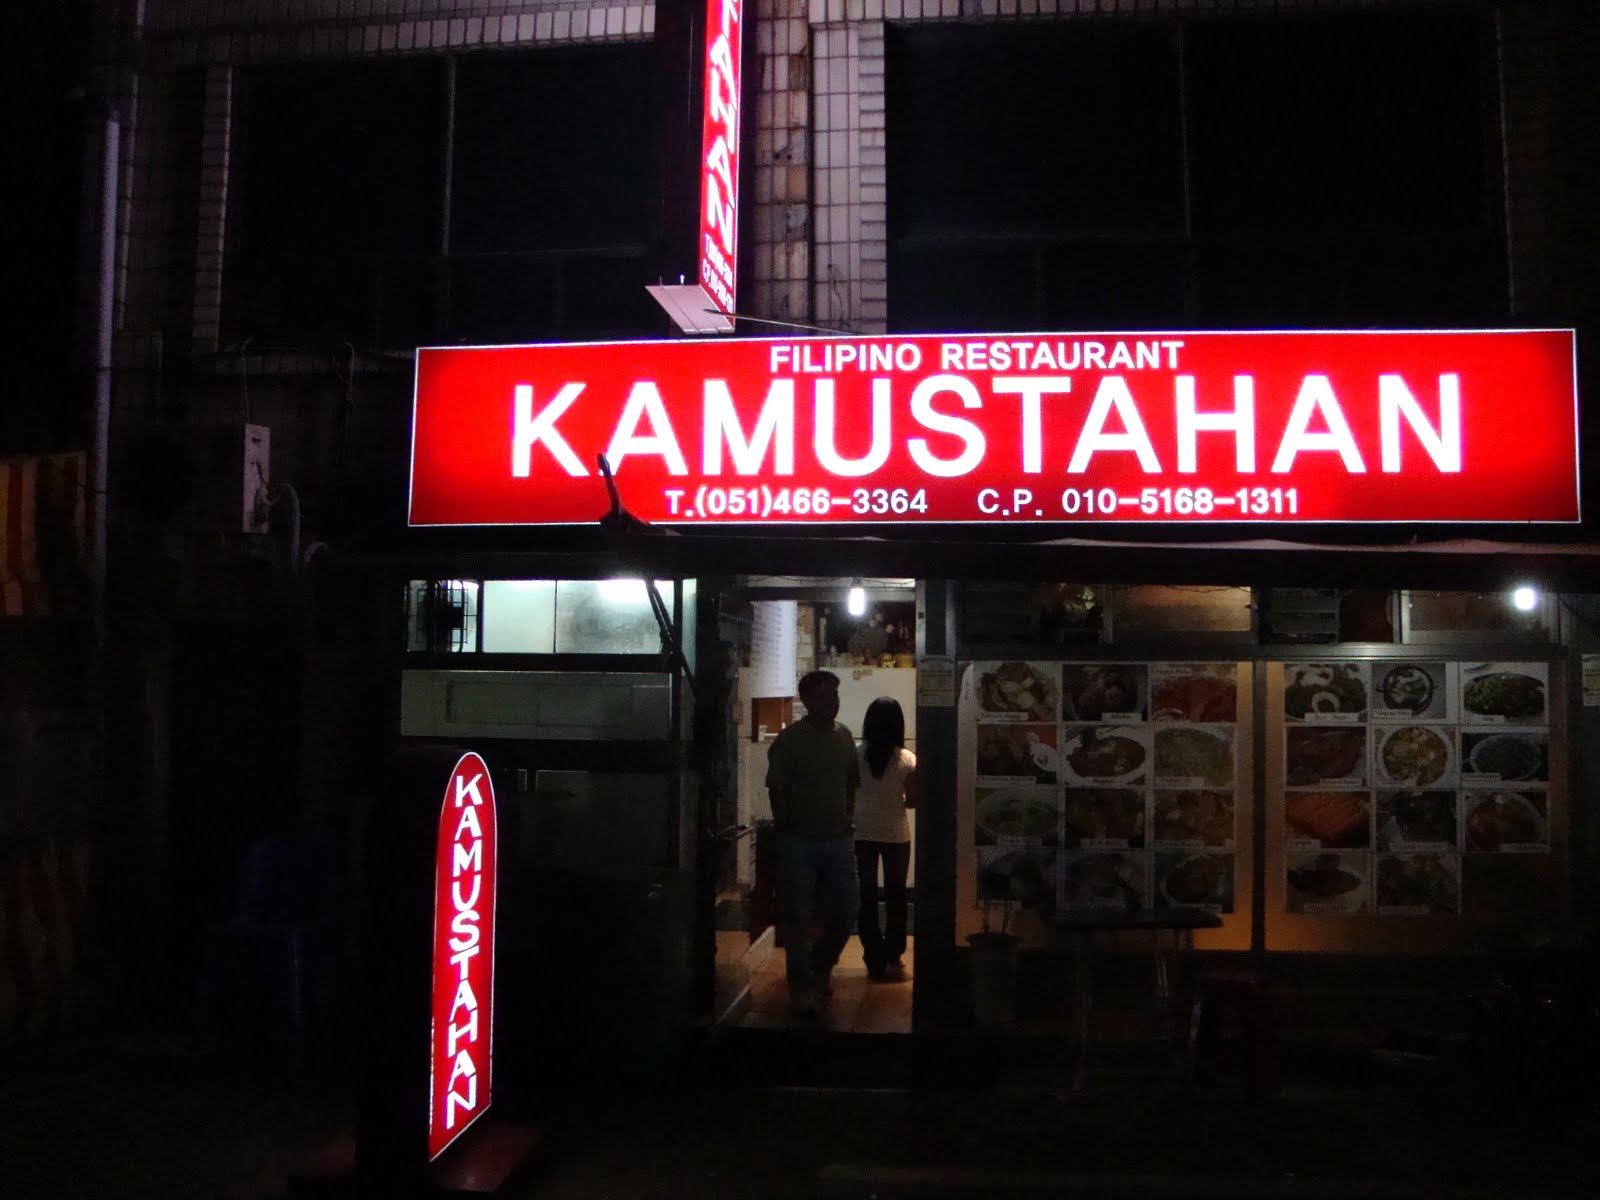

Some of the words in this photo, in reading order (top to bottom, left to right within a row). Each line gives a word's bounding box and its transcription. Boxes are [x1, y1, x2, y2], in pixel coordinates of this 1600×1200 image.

[770, 343, 922, 373] FILIPINO
[941, 340, 1185, 371] RESTAURANT
[510, 373, 1464, 478] KAMUSTAHAN
[977, 488, 1043, 517] C.P.
[1061, 487, 1298, 515] 010-5168-1311
[446, 773, 484, 1130] KAMUSTAHAN
